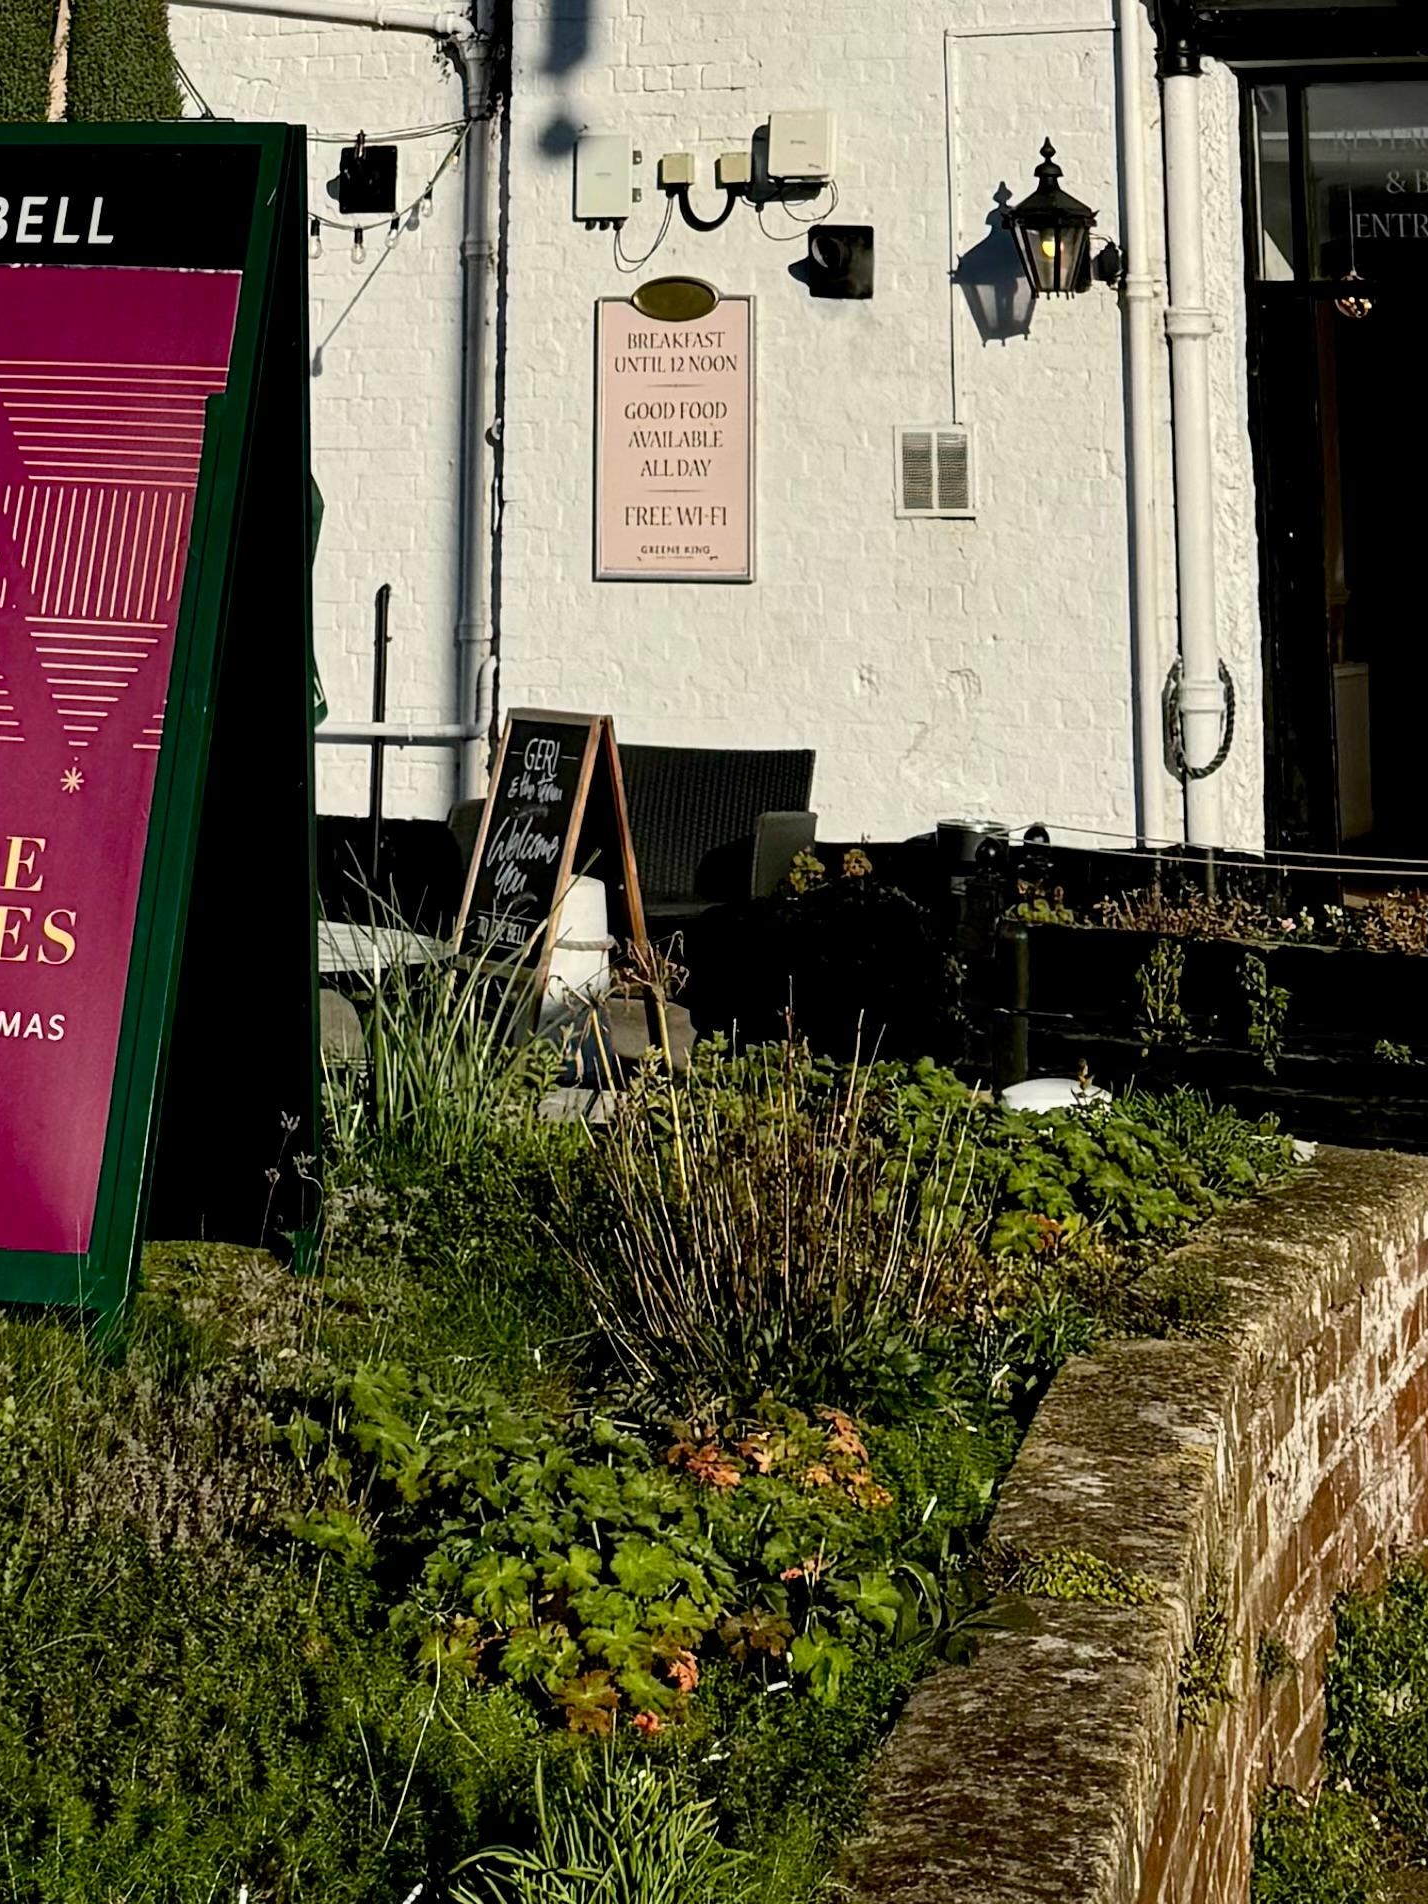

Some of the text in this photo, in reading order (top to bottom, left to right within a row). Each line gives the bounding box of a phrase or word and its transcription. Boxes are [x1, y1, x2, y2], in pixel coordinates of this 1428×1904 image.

[1385, 169, 1406, 194] &
[627, 331, 726, 350] BREAKFAST
[614, 355, 738, 374] UNTIL 12 NOON
[624, 401, 728, 420] GOOD FOOD
[628, 430, 724, 449] AVAILABLE
[640, 459, 712, 478] ALL DAY
[625, 505, 727, 527] FREE WI-FI
[640, 545, 711, 555] GREENE KING
[524, 738, 560, 779] GERI
